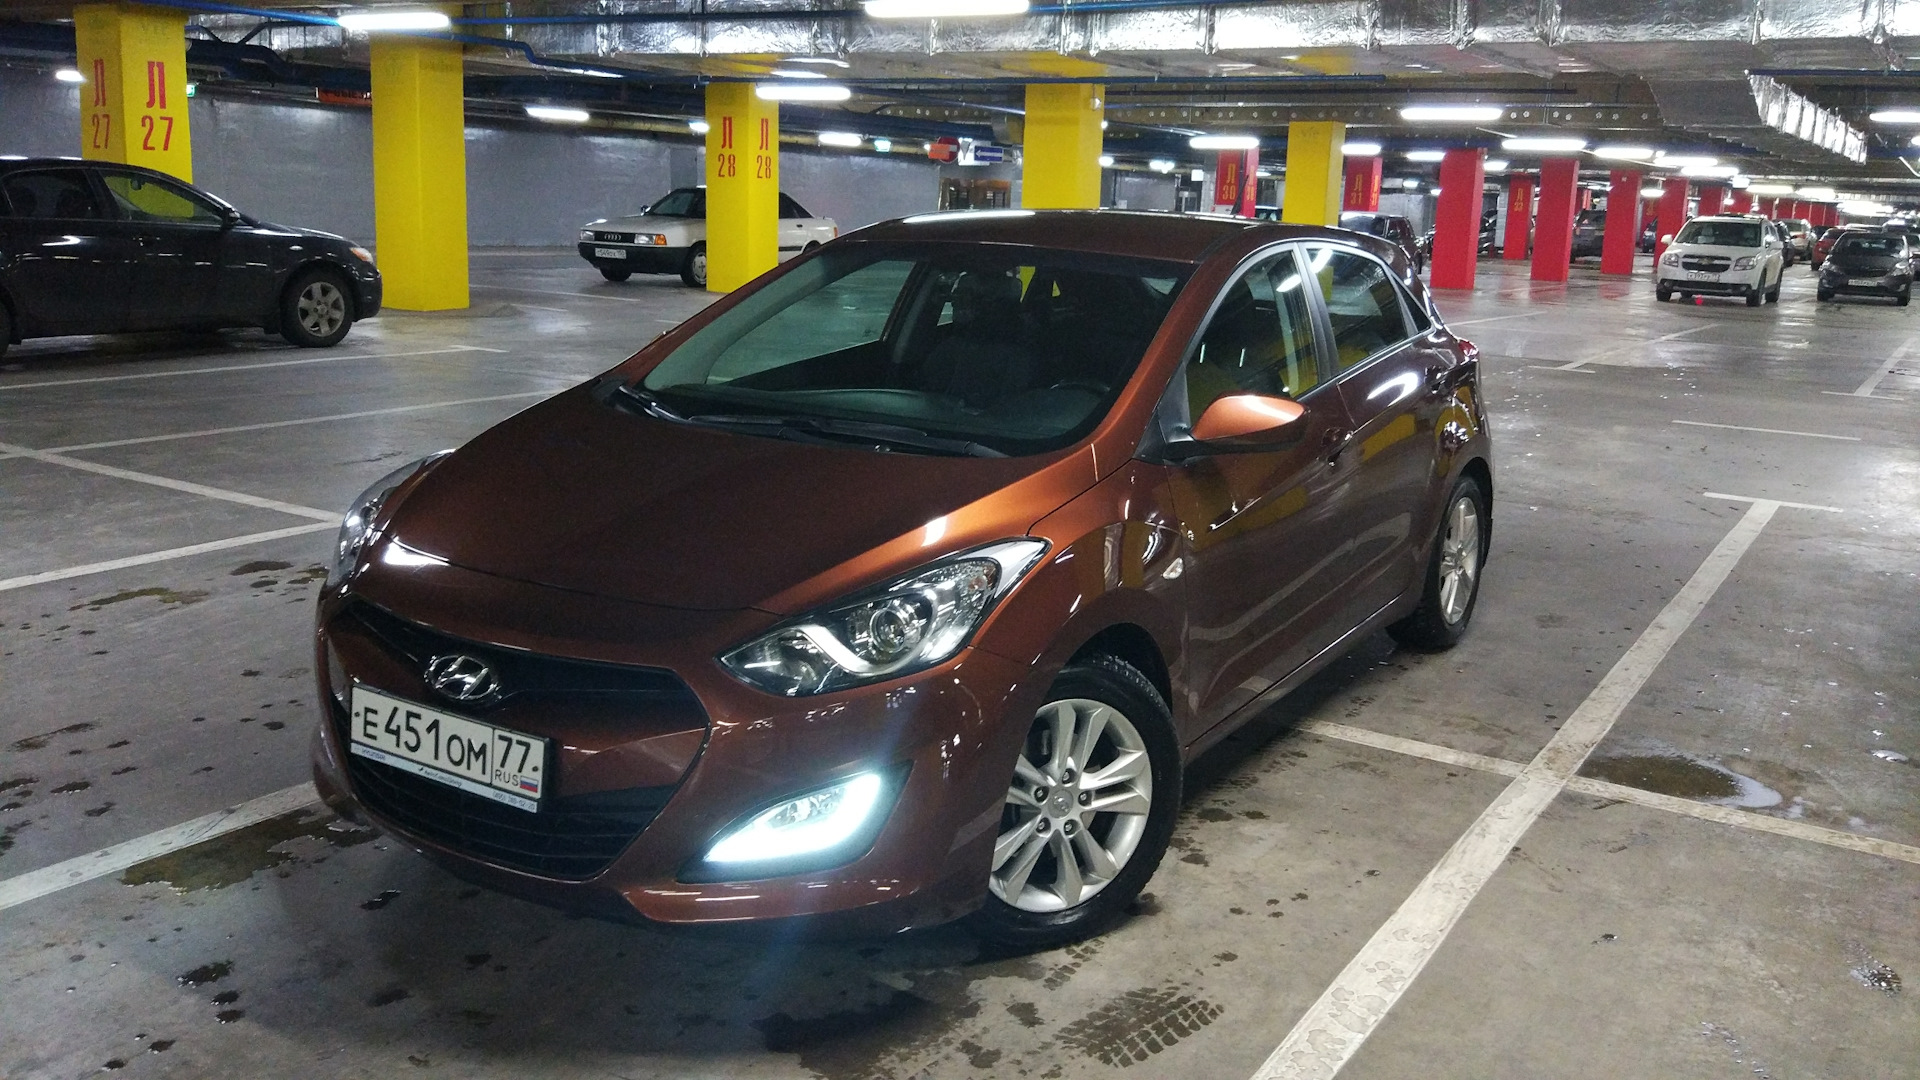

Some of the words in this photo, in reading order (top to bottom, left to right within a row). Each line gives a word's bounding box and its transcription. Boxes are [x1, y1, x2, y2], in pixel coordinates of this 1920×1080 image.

[93, 59, 106, 107] Л
[146, 61, 166, 109] Л
[92, 114, 110, 149] 27
[141, 115, 173, 151] 27
[722, 116, 732, 149] Л
[760, 118, 769, 150] Л
[718, 153, 736, 177] 28
[757, 155, 771, 178] 28
[1222, 185, 1236, 200] 30
[498, 734, 531, 774] 77
[494, 769, 519, 787] RUS
